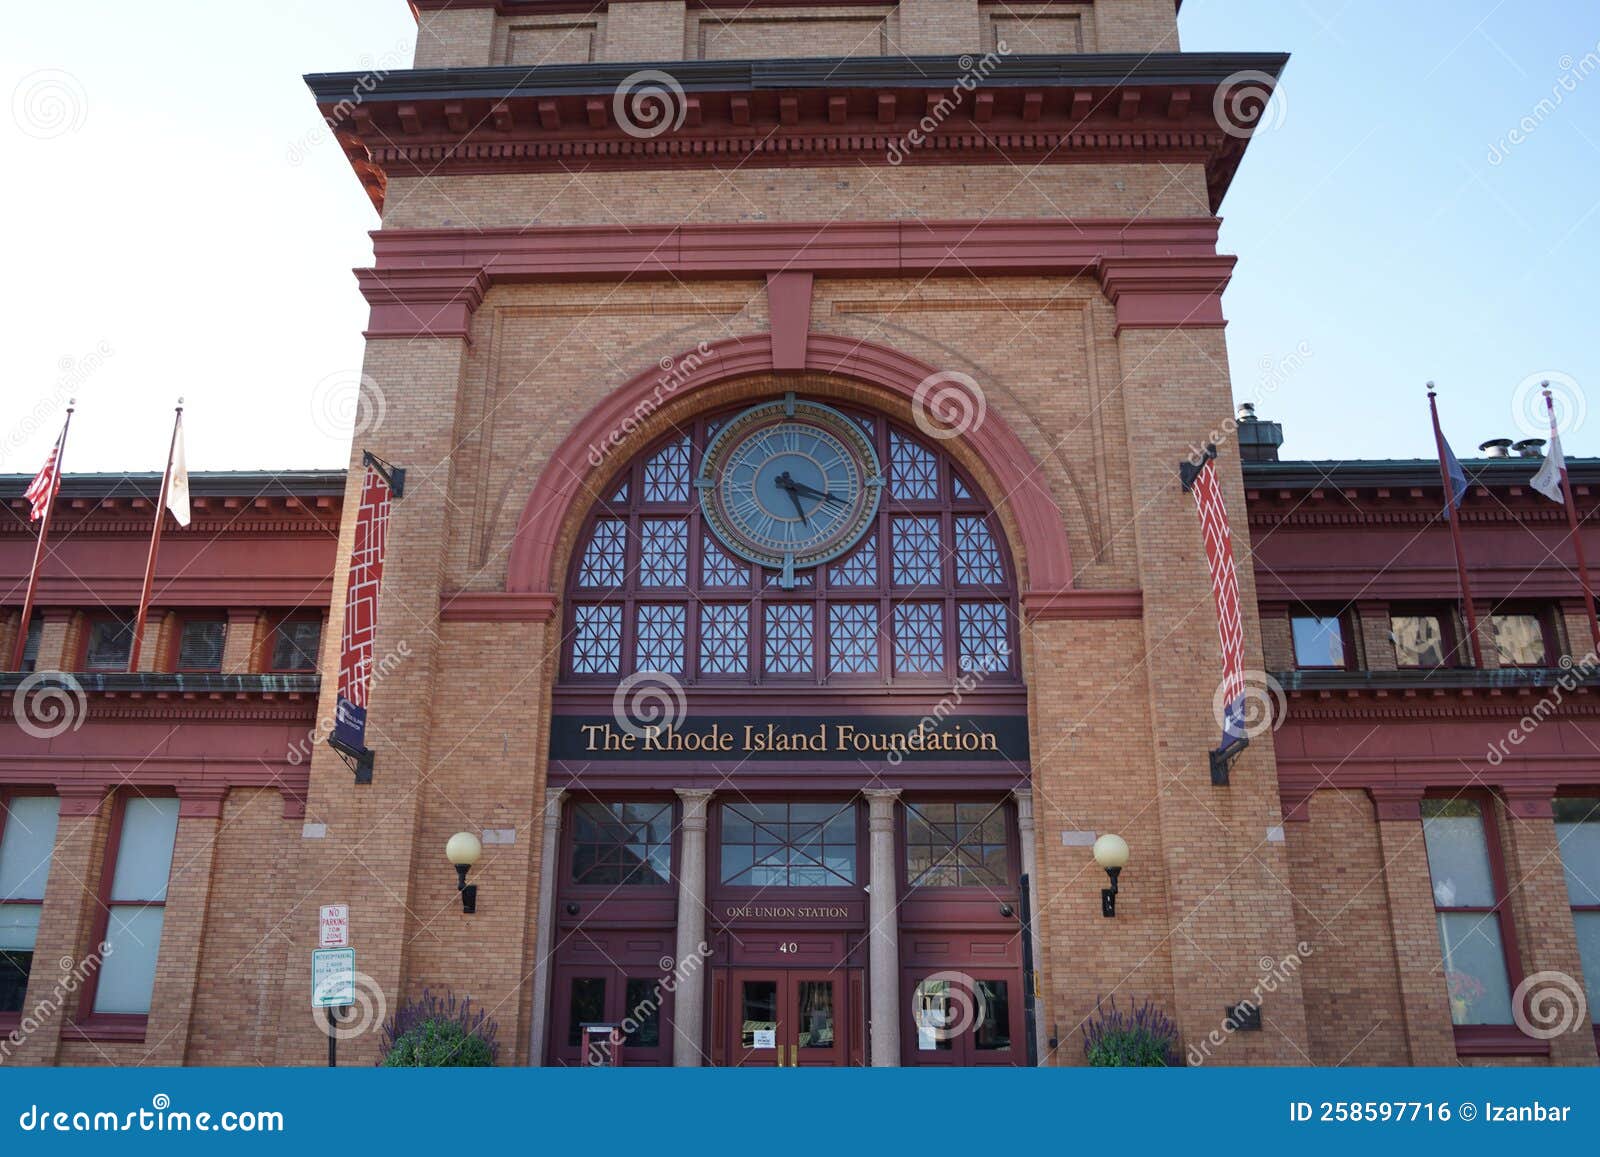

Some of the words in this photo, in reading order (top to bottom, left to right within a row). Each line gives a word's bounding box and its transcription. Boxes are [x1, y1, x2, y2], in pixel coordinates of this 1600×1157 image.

[581, 724, 636, 751] The
[643, 724, 734, 751] Rhode
[744, 724, 827, 751] Island
[836, 724, 999, 751] Foundation
[329, 909, 340, 917] NO
[727, 907, 752, 917] ONE
[755, 907, 795, 917] UNION
[798, 907, 848, 917] STATION
[322, 918, 345, 926] PARKING
[780, 942, 797, 953] 40
